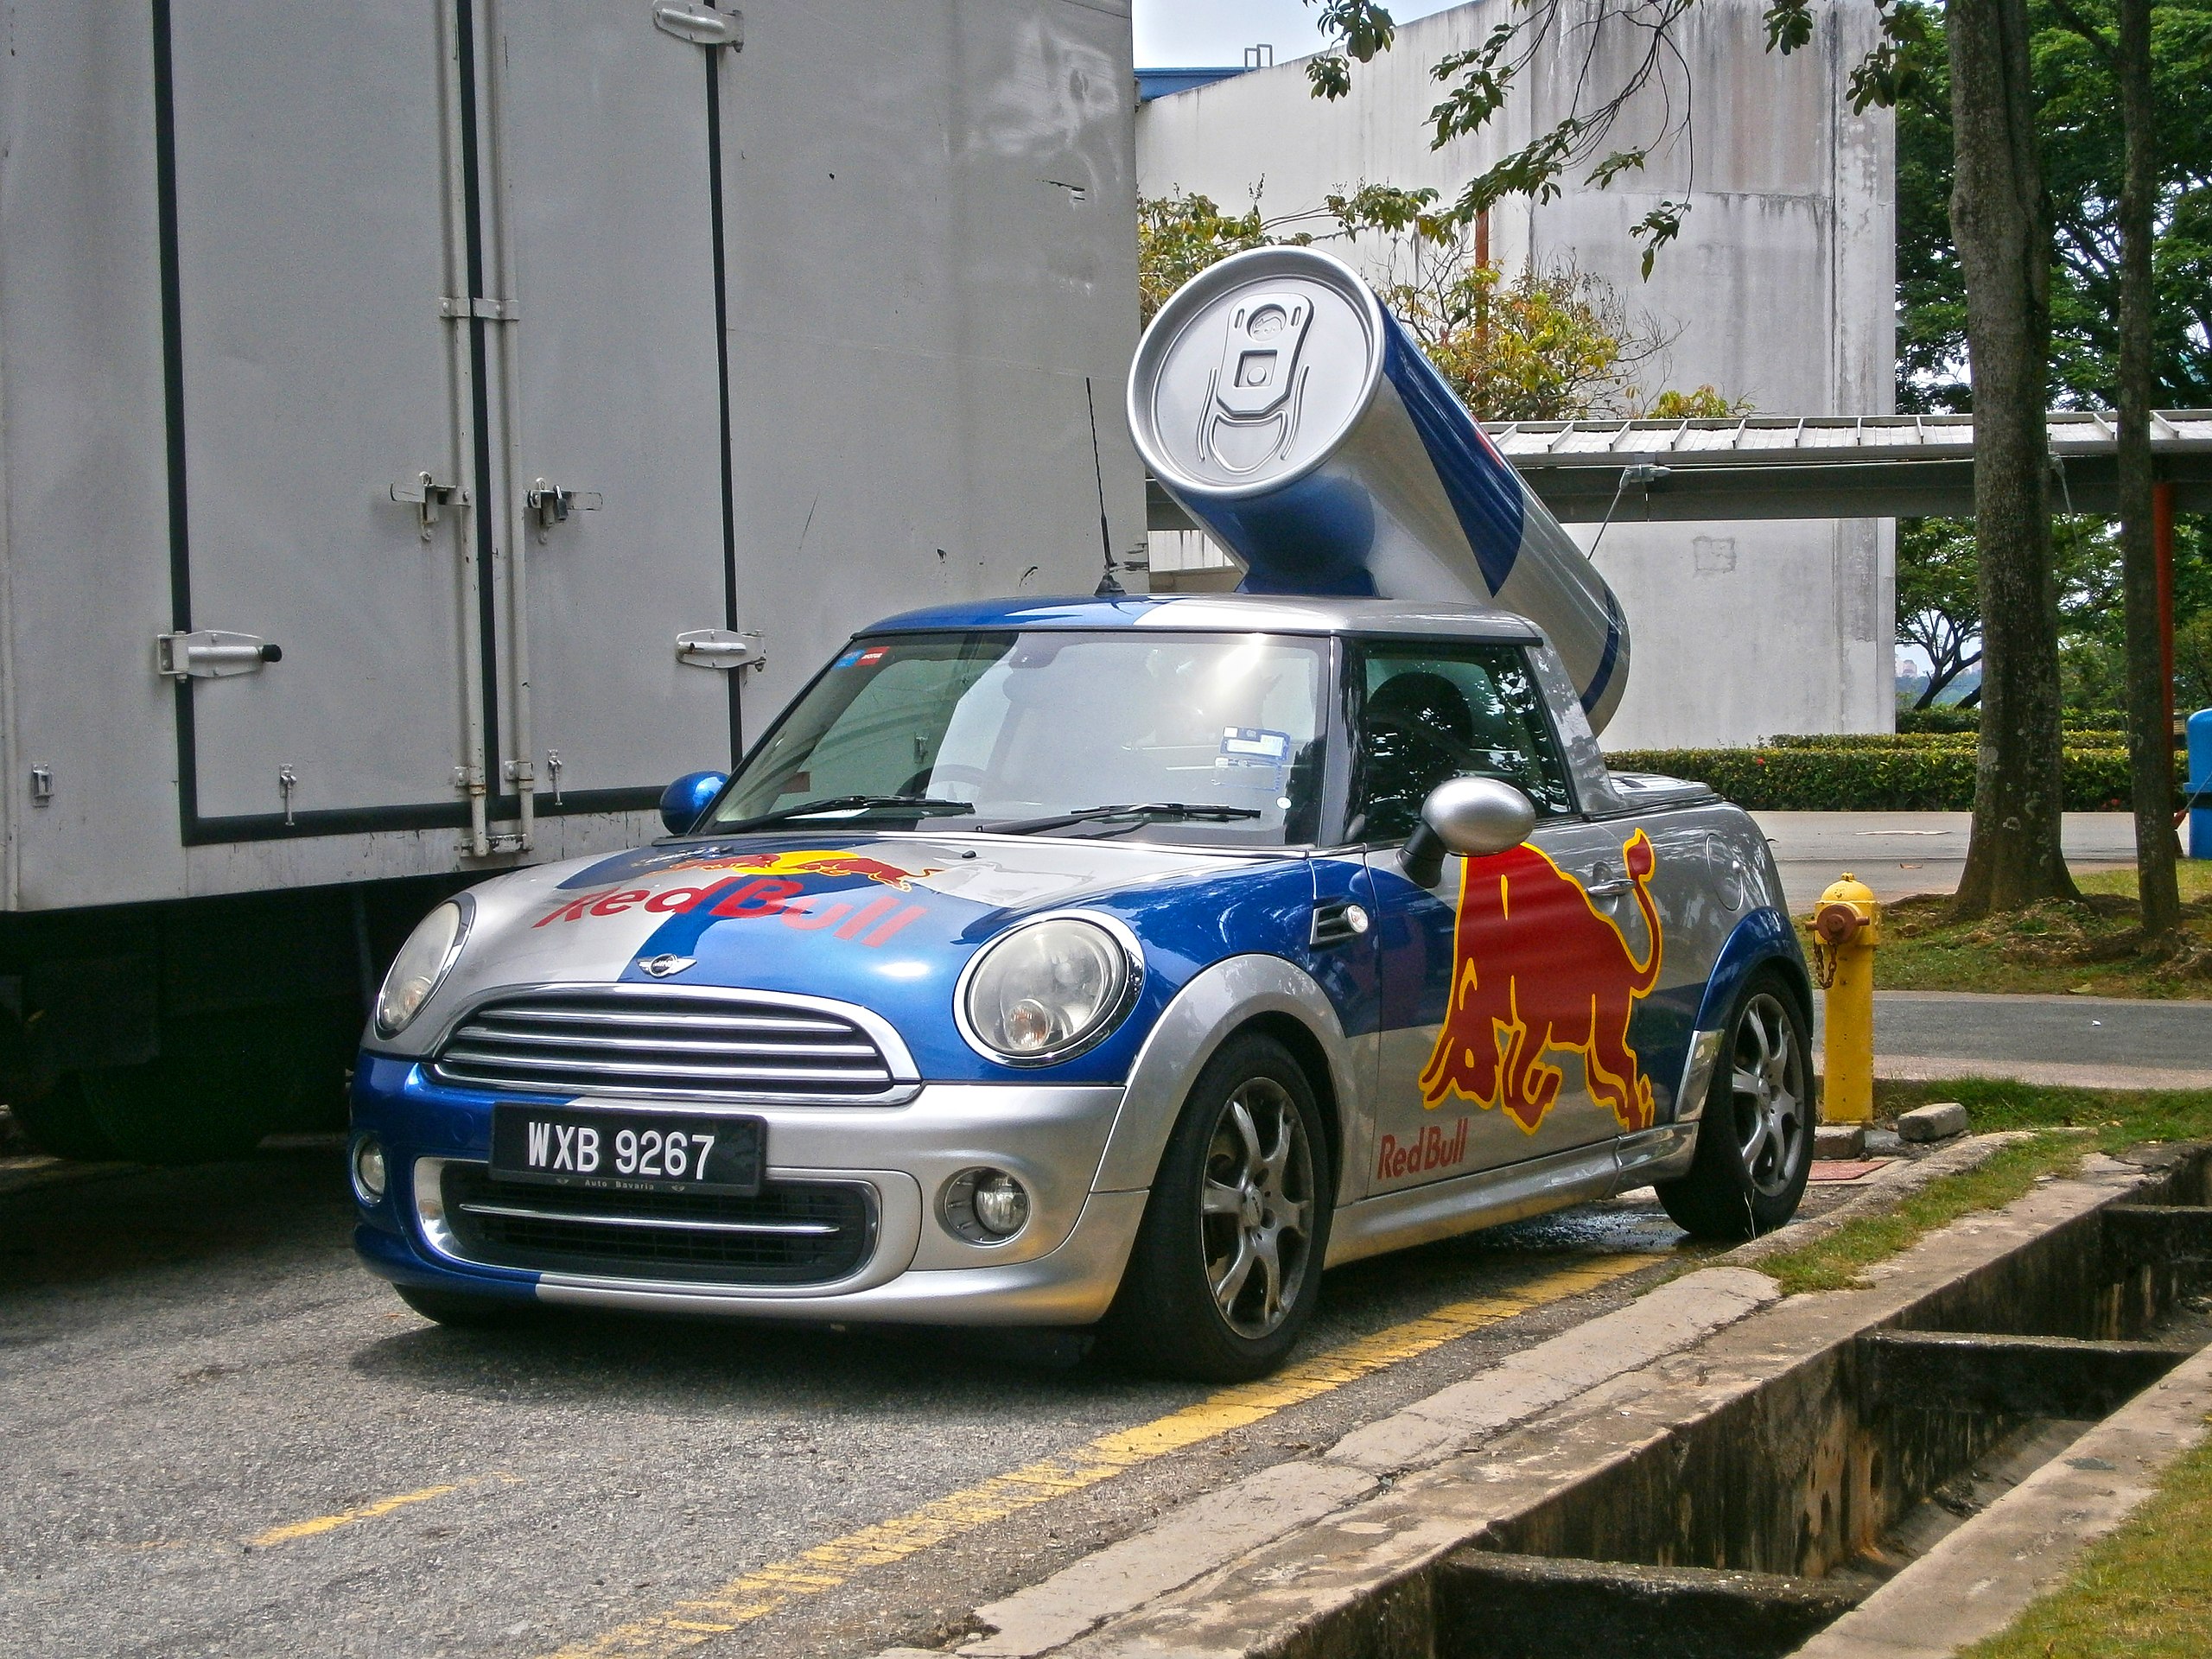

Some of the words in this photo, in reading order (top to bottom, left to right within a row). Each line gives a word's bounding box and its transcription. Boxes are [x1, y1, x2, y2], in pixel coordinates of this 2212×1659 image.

[531, 876, 741, 929] Red
[709, 878, 928, 948] Bull
[529, 1122, 600, 1173] WXB
[615, 1129, 715, 1180] 9267
[1377, 1126, 1425, 1180] Red
[1423, 1117, 1469, 1171] Bull
[584, 1179, 607, 1188] Auto
[615, 1180, 654, 1190] Bavaria
